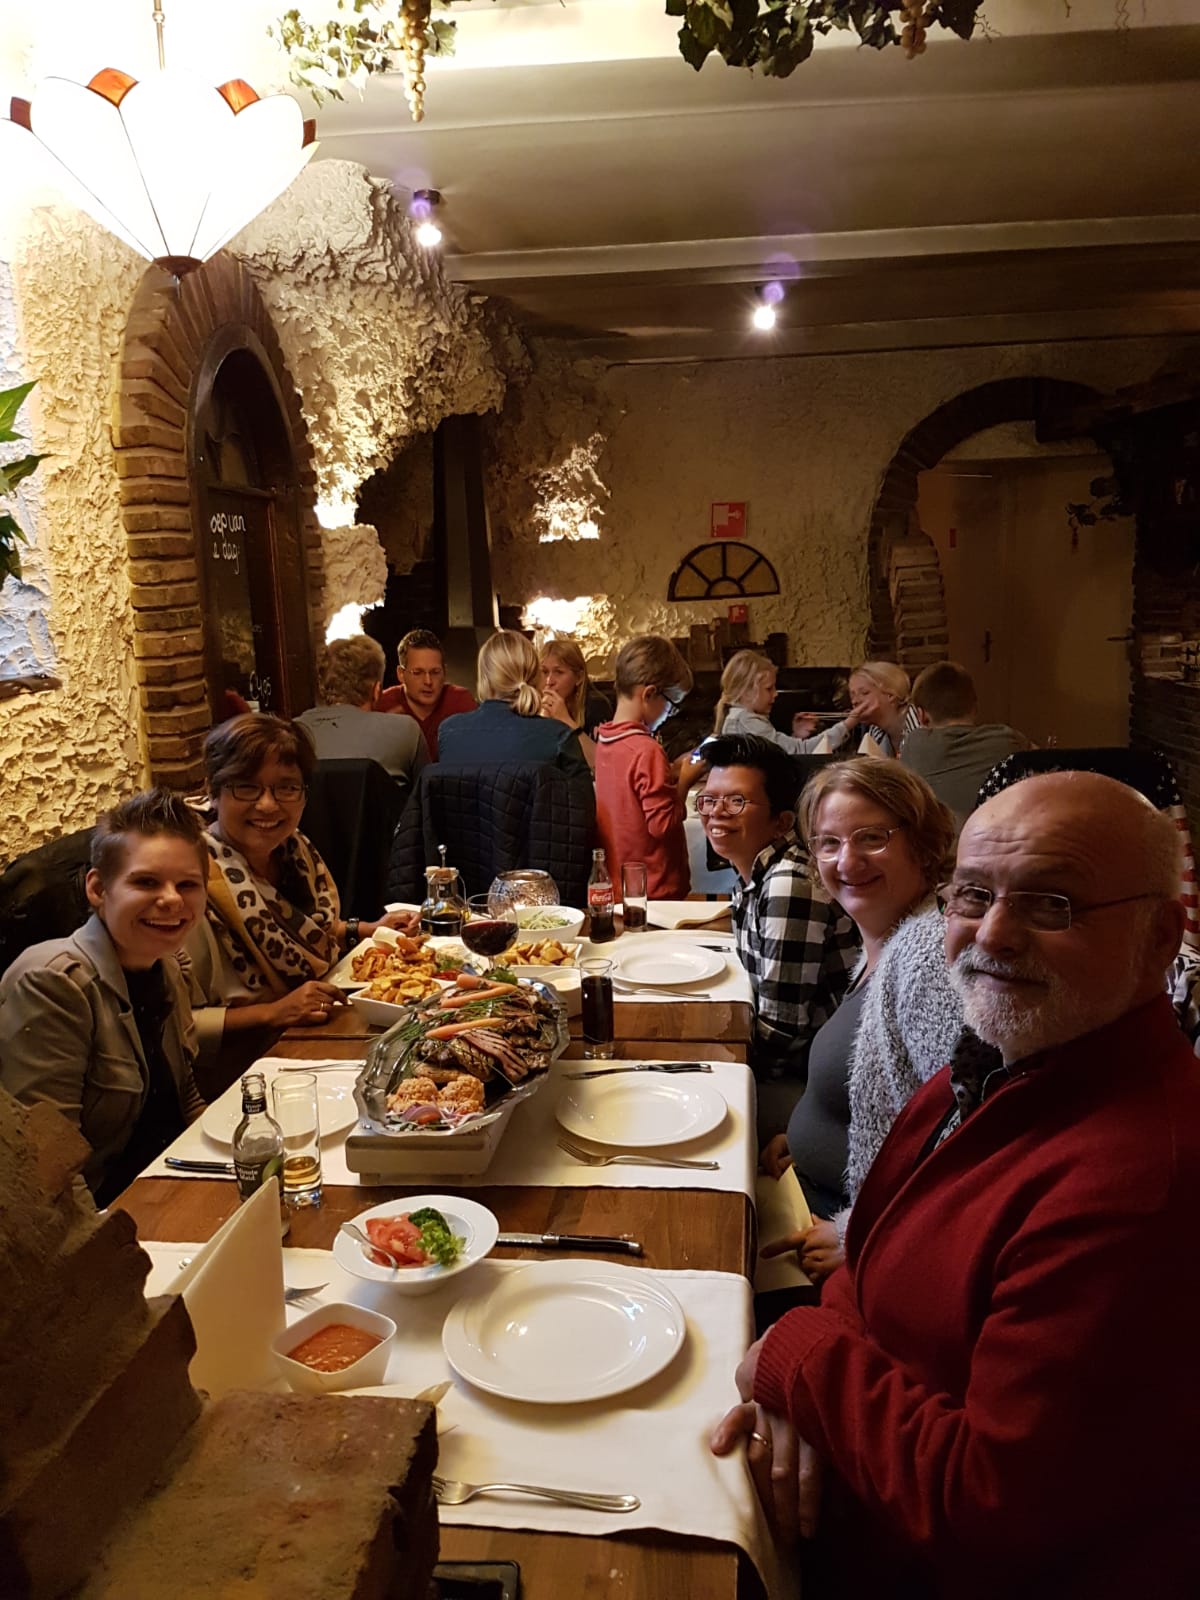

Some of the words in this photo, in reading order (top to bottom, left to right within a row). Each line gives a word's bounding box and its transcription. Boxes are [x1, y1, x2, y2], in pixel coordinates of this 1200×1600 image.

[210, 512, 228, 540] oep
[227, 514, 247, 533] van
[237, 1167, 258, 1175] Minute
